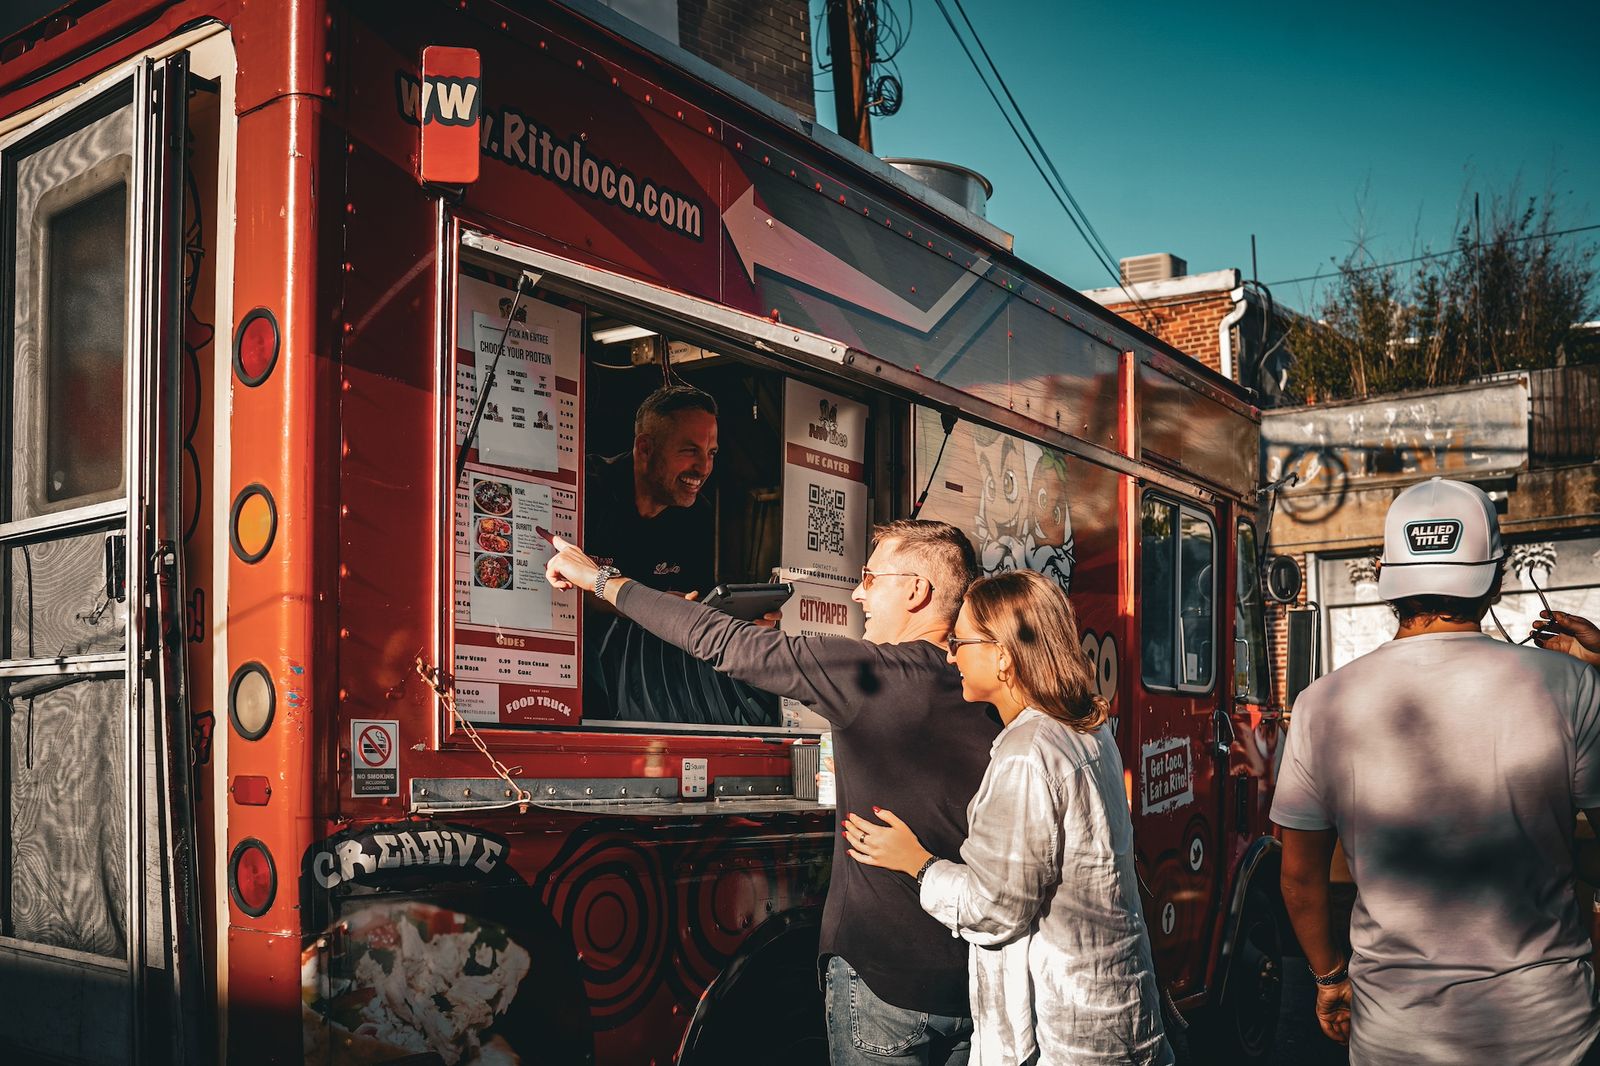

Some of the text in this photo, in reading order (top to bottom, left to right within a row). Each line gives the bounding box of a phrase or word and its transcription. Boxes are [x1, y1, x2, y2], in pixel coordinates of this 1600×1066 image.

[521, 331, 529, 341] AN
[480, 340, 552, 366] CHOOSE YOUR PROTEIN
[806, 452, 850, 474] WE CATER
[1411, 525, 1454, 536] ALLIED
[1415, 535, 1450, 546] TITLE
[800, 598, 848, 627] CITYPAPER
[505, 696, 572, 717] FOOD TRUCK
[1150, 753, 1184, 778] Get Loco,
[1150, 768, 1187, 801] Eat a Rito!
